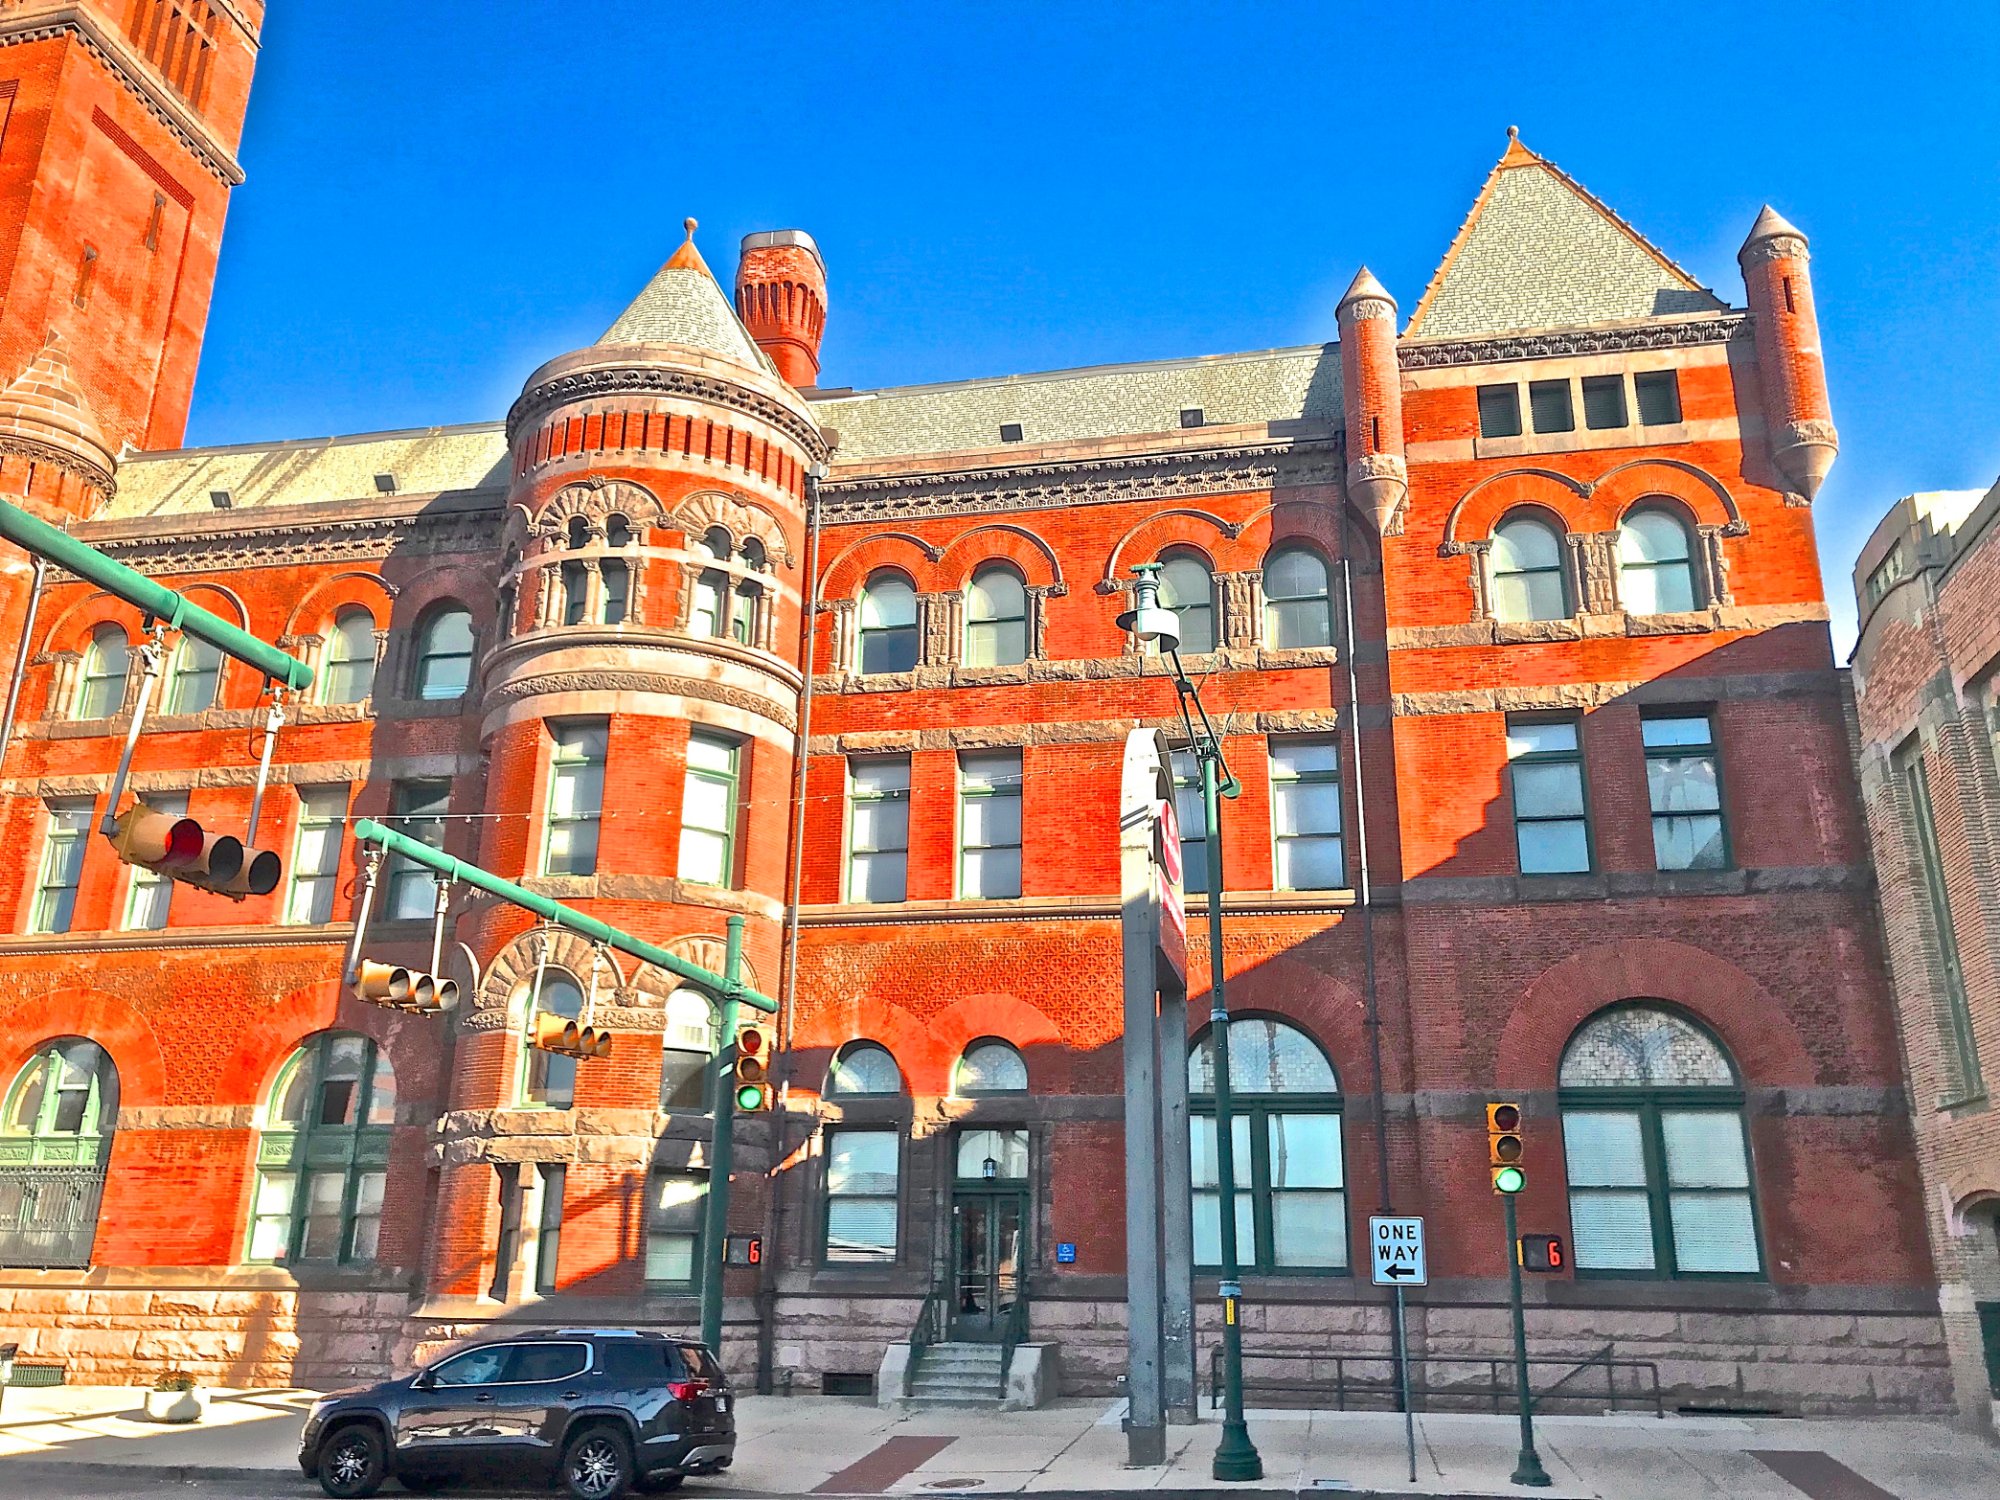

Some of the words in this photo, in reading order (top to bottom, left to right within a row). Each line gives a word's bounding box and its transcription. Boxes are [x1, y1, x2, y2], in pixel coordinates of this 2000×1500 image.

[1378, 1224, 1417, 1240] ONE
[750, 1240, 760, 1263] 6
[1378, 1245, 1419, 1262] WAY
[1549, 1241, 1561, 1267] 6
